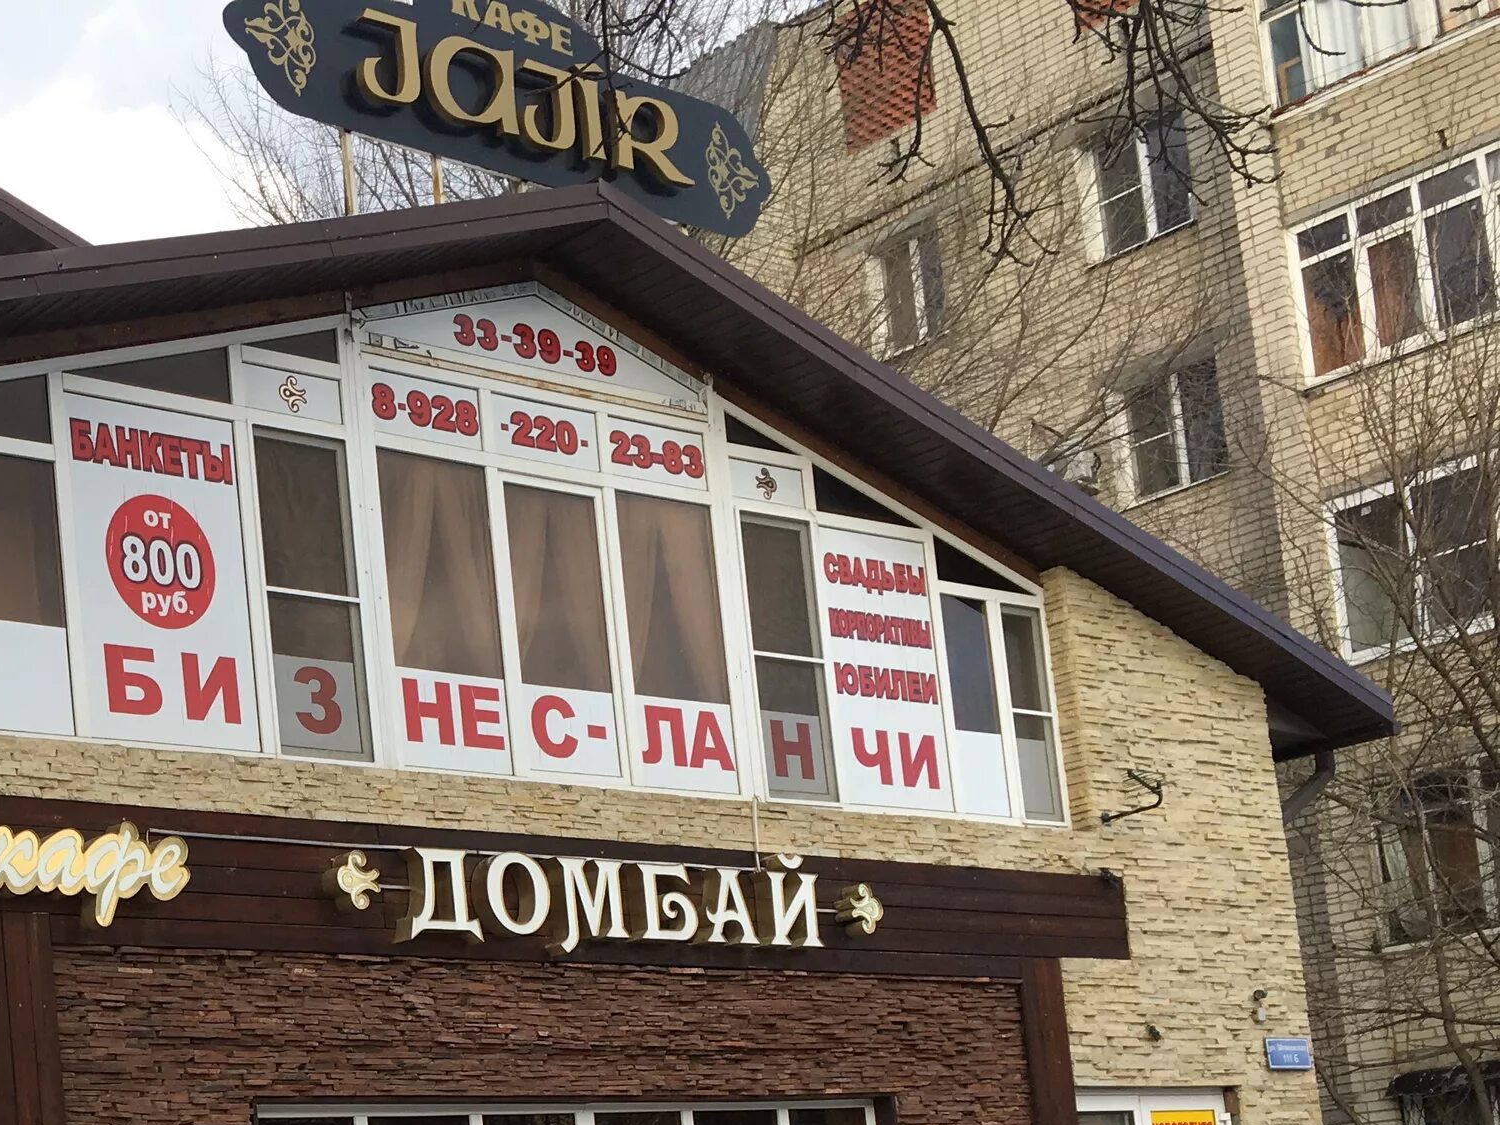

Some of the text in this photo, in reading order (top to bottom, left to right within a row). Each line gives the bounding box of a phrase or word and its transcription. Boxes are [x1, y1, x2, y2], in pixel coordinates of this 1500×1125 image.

[453, 313, 617, 377] 33-39-39
[69, 417, 234, 486] БАНКЕТЫ
[121, 534, 203, 590] 800
[823, 551, 928, 597] СВАДЬБЫ
[141, 590, 196, 616] руб.
[828, 607, 933, 650] КОРПОРАТИВЫ
[409, 846, 825, 954] ДОМБАЙ
